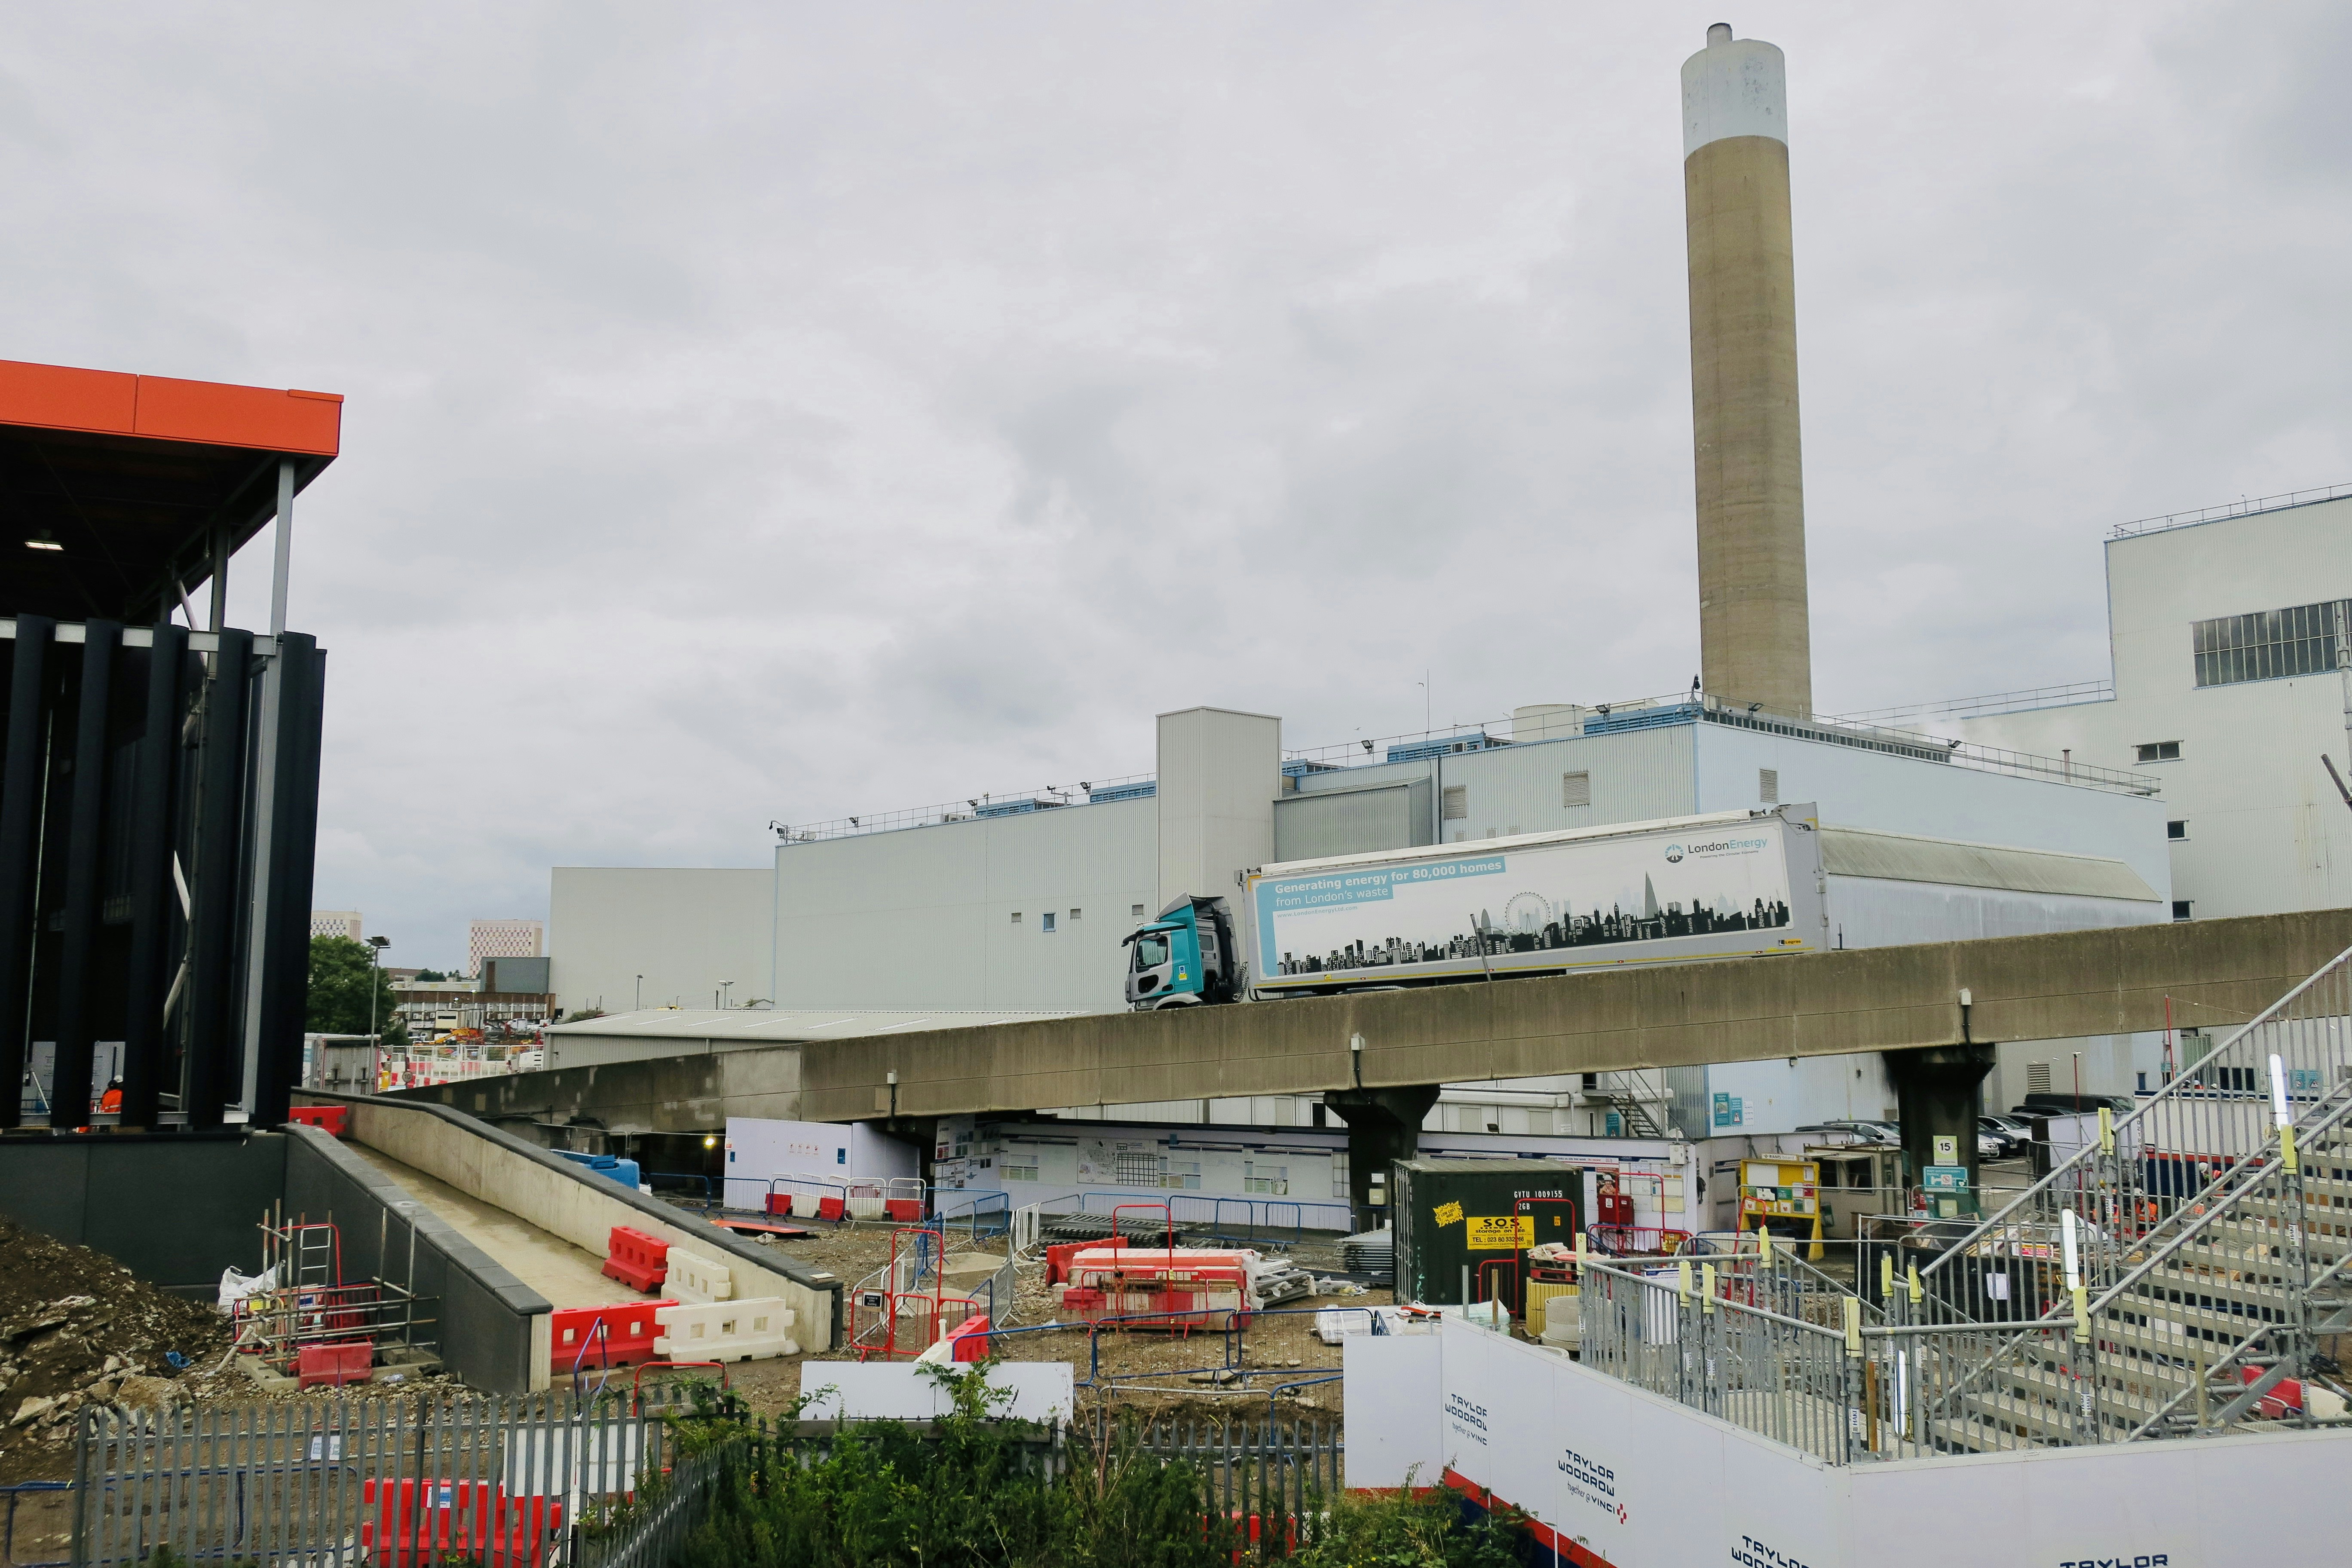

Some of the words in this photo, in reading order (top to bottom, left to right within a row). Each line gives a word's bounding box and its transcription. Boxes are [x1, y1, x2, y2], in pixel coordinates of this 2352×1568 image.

[1688, 839, 1767, 854] LondonEnergy
[1275, 879, 1341, 894] Generating
[1345, 876, 1387, 887] energy
[1391, 871, 1409, 881] for
[1413, 866, 1456, 880] 80,000
[1460, 861, 1502, 874] homes
[1276, 896, 1301, 907] from
[1305, 890, 1353, 903] London's
[1357, 887, 1388, 897] waste
[1277, 905, 1358, 918] www.LondonEnergyLtd.com
[1940, 1143, 1951, 1151] 15
[1483, 1218, 1519, 1227] SOS
[1451, 1393, 1487, 1417] TAYLOR
[1471, 1432, 1487, 1446] VINC
[1566, 1449, 1614, 1482] TAYLOR
[1558, 1460, 1614, 1497] WOODROW
[1568, 1481, 1585, 1497] together
[1591, 1495, 1615, 1514] VINCI
[1742, 1535, 1810, 1568] TAYLO
